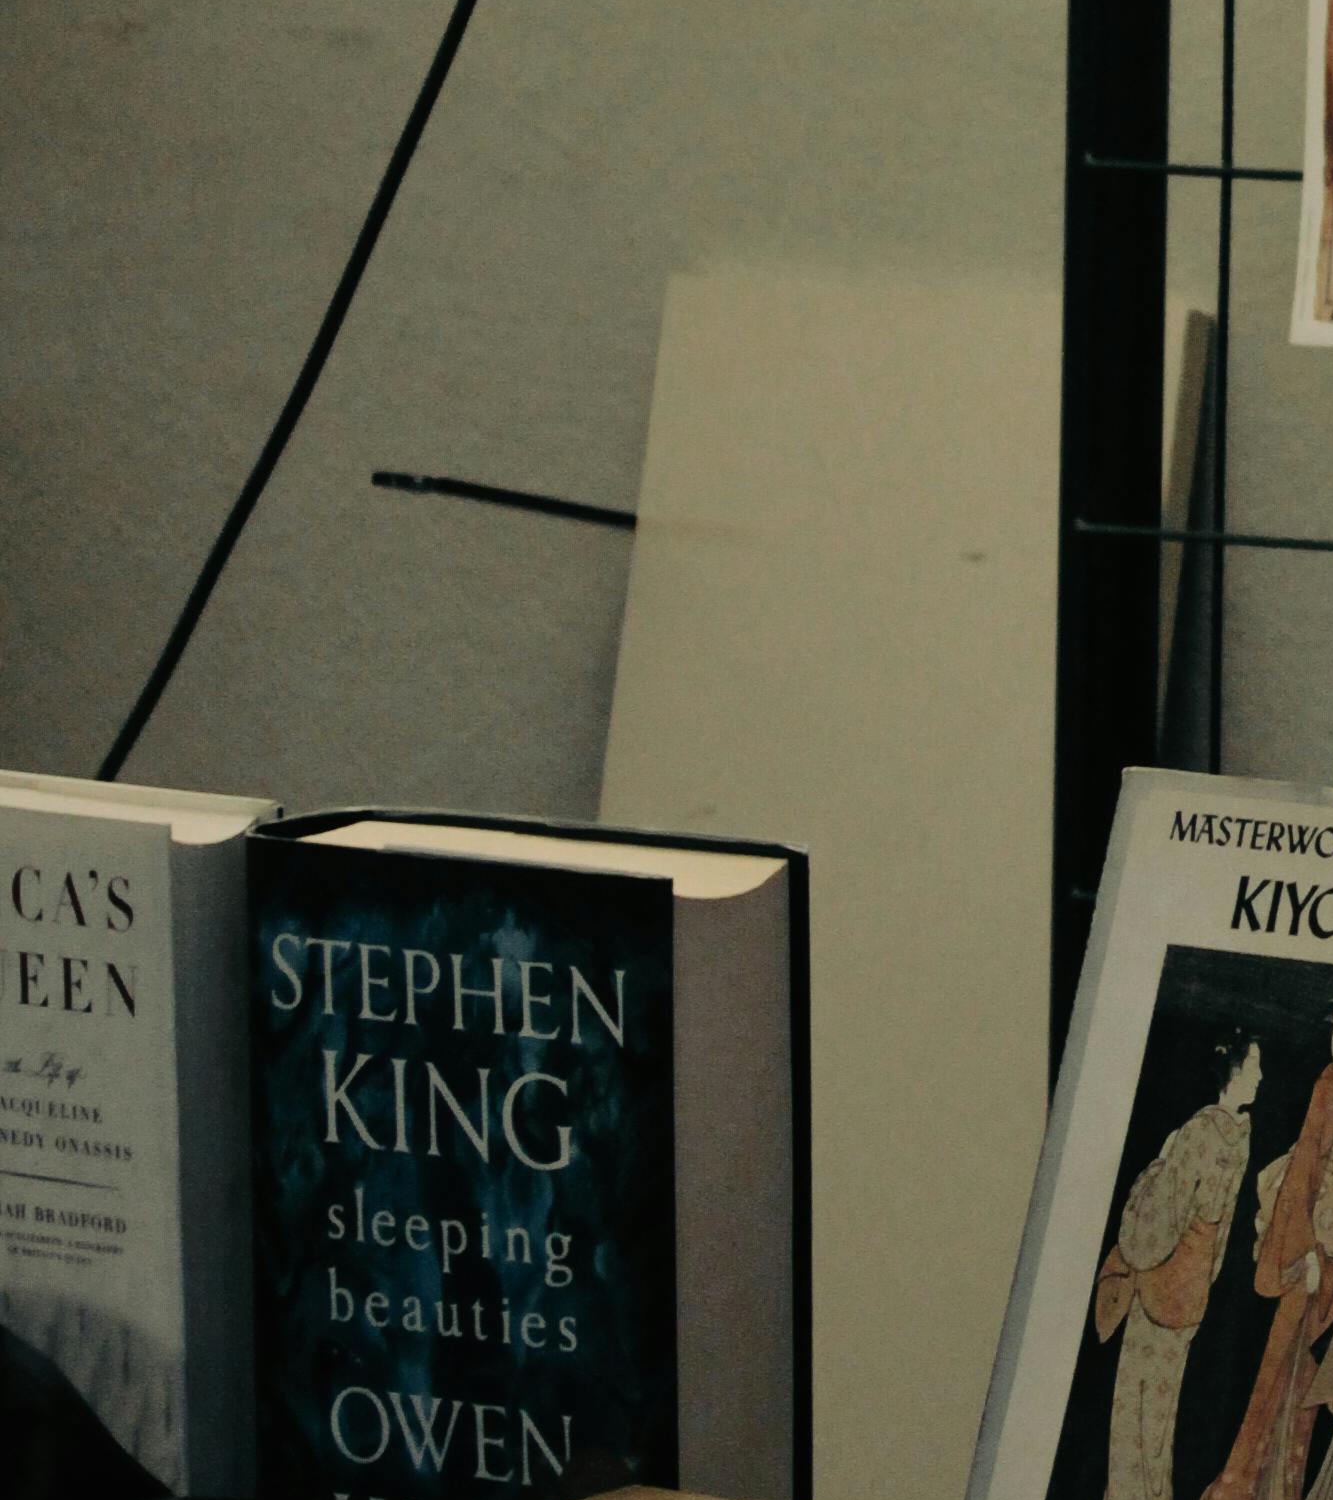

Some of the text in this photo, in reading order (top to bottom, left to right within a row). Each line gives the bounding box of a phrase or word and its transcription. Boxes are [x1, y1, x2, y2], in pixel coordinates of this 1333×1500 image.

[0, 947, 137, 1018] EEN
[270, 930, 627, 1049] STEPHEN
[322, 1047, 575, 1172] KING
[34, 1205, 127, 1235] BRADFORD
[327, 1187, 575, 1289] sleeping
[328, 1267, 579, 1355] beauties
[329, 1385, 573, 1487] OWEN
